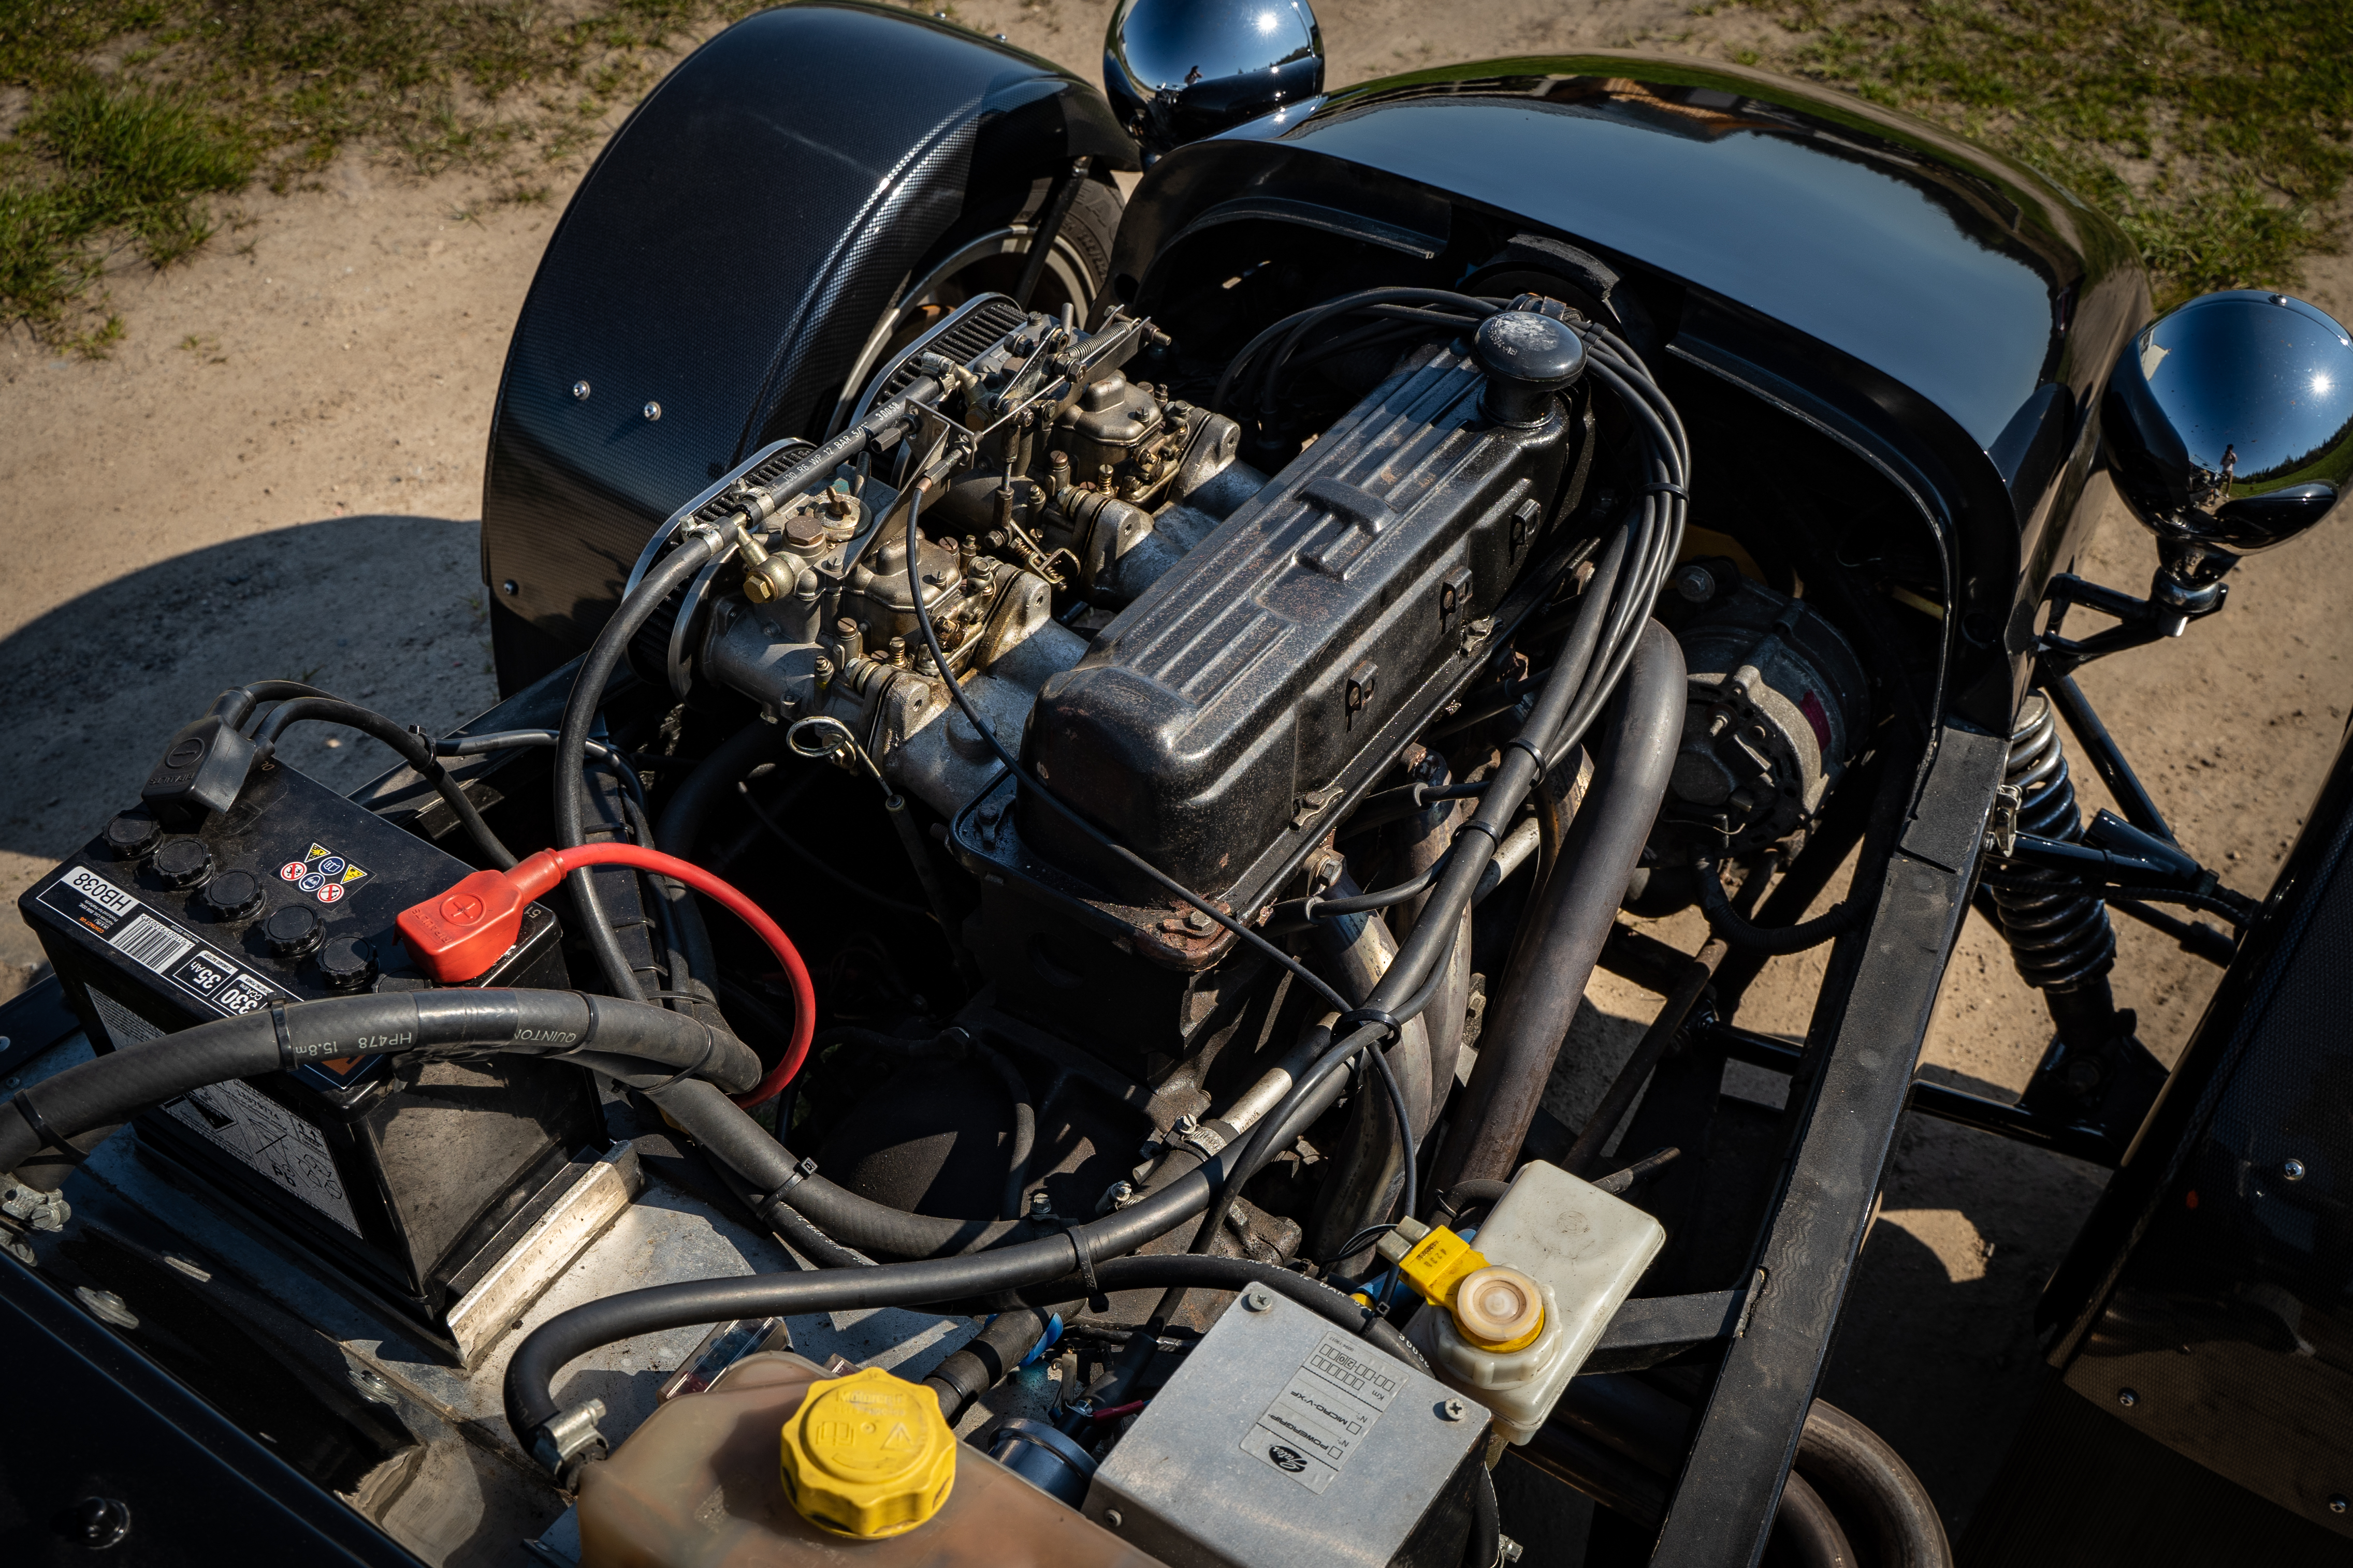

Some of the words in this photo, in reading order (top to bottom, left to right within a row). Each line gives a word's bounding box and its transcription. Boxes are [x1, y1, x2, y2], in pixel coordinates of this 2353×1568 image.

[768, 481, 782, 494] AE
[782, 470, 798, 485] J30
[796, 462, 810, 475] R6
[808, 453, 824, 467] WP
[823, 446, 835, 458] 12
[834, 434, 852, 450] BAR
[875, 400, 901, 421] 30058
[149, 772, 194, 785] RIPAULTS
[72, 871, 132, 911] HB038
[524, 906, 541, 918] 51
[85, 920, 105, 933] CONTACT
[411, 908, 453, 943] RIPAULTS
[165, 929, 187, 944] 015025
[203, 952, 217, 962] BATTERY
[216, 960, 232, 971] STANDARD
[244, 977, 257, 986] POWER
[219, 988, 259, 1015] 330
[245, 987, 263, 1001] CCA
[356, 1031, 412, 1049] HP478
[270, 1163, 298, 1190] Pb
[806, 1222, 824, 1239] BAR
[1370, 1389, 1385, 1401] Km
[1272, 1443, 1306, 1472] Gates
